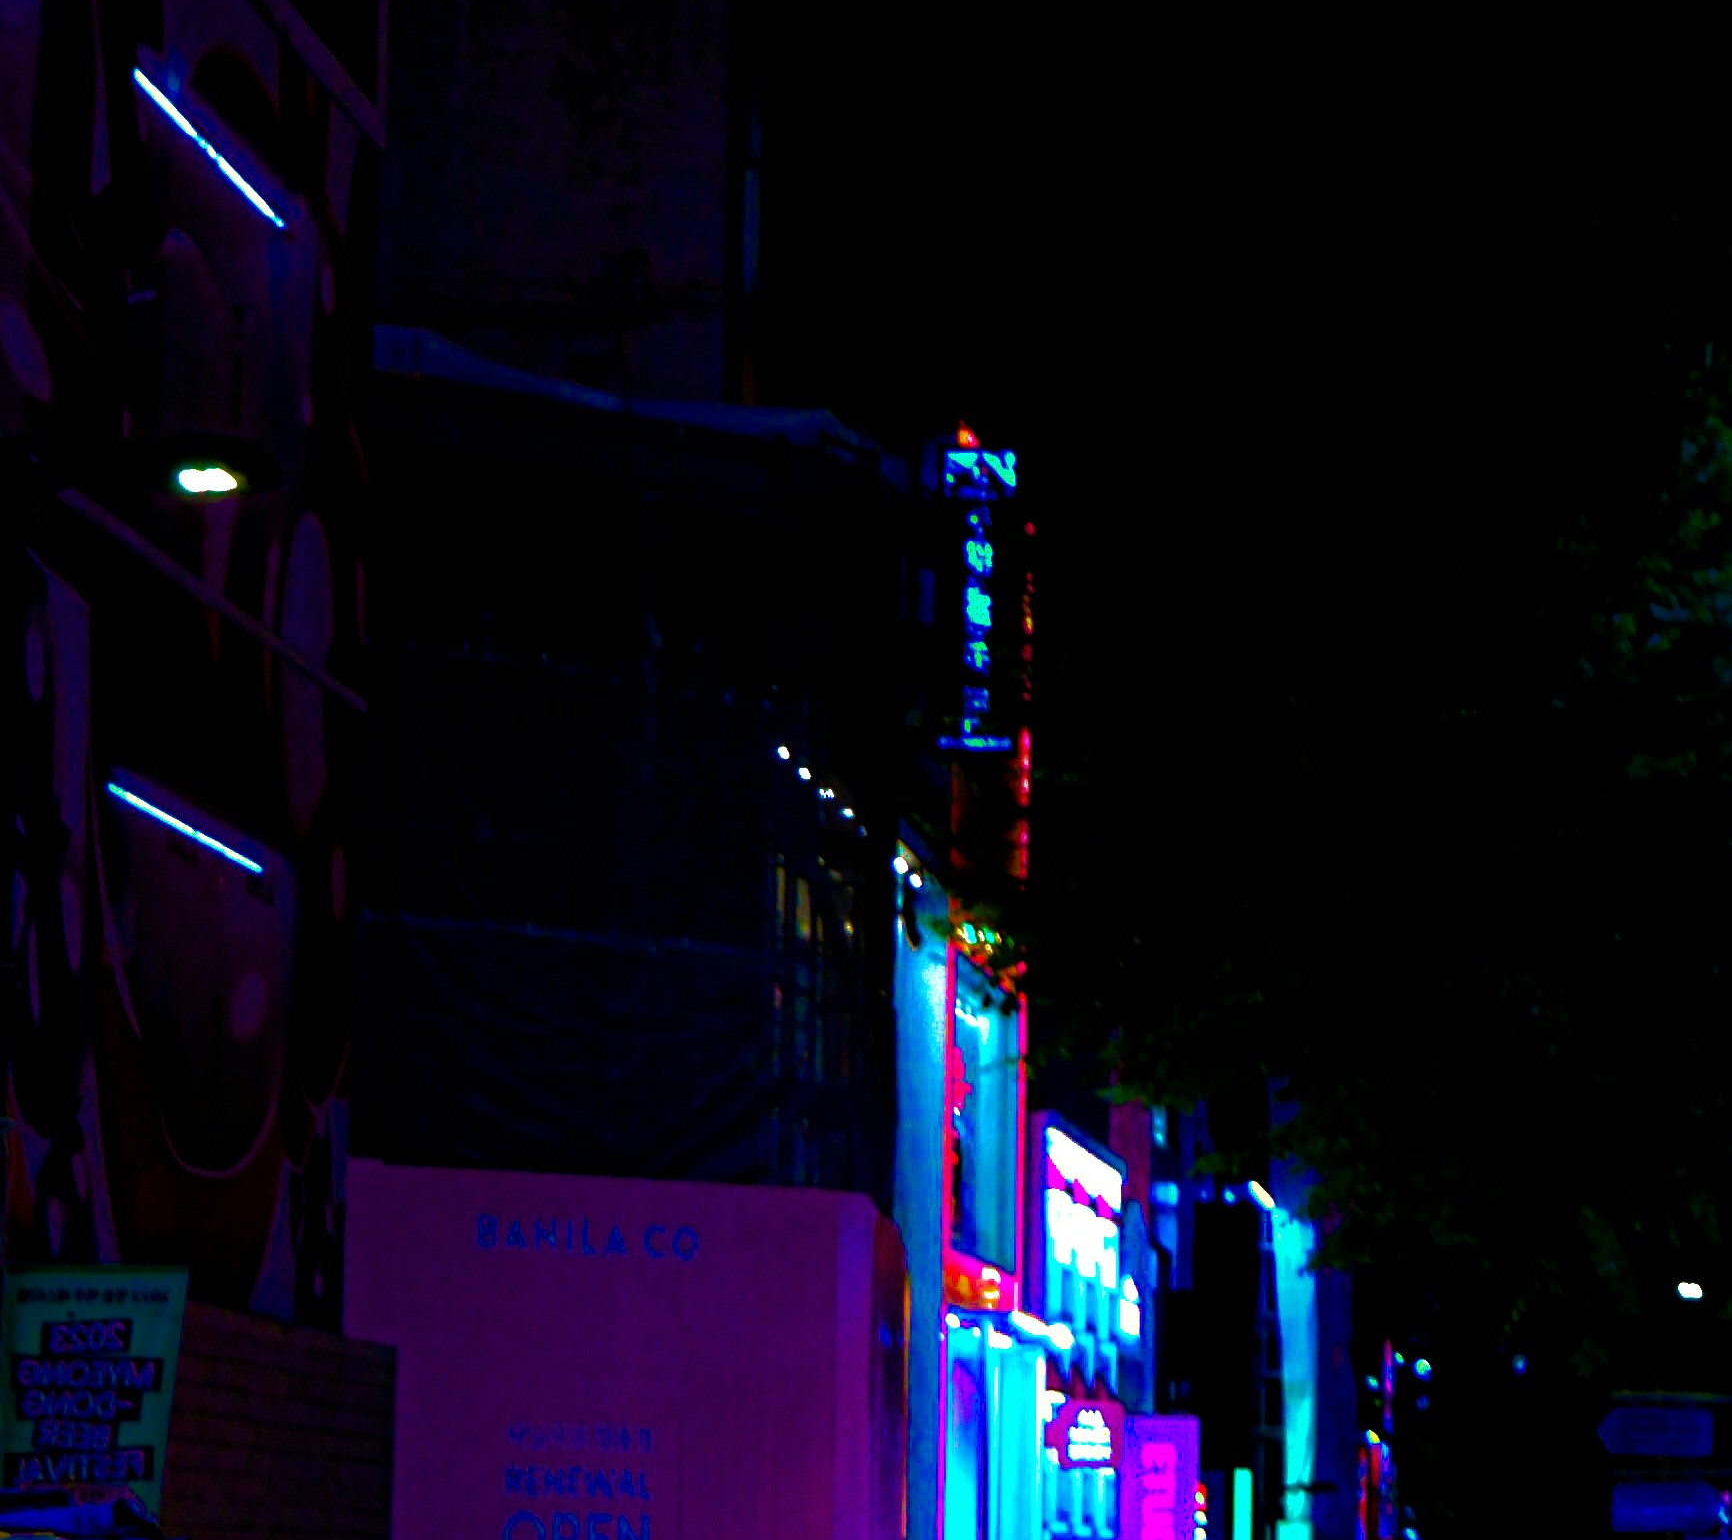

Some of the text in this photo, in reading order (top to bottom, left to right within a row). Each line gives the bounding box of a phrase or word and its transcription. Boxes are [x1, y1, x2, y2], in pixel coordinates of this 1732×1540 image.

[476, 1213, 701, 1261] BANILA CO
[505, 1465, 653, 1500] RENEWAL
